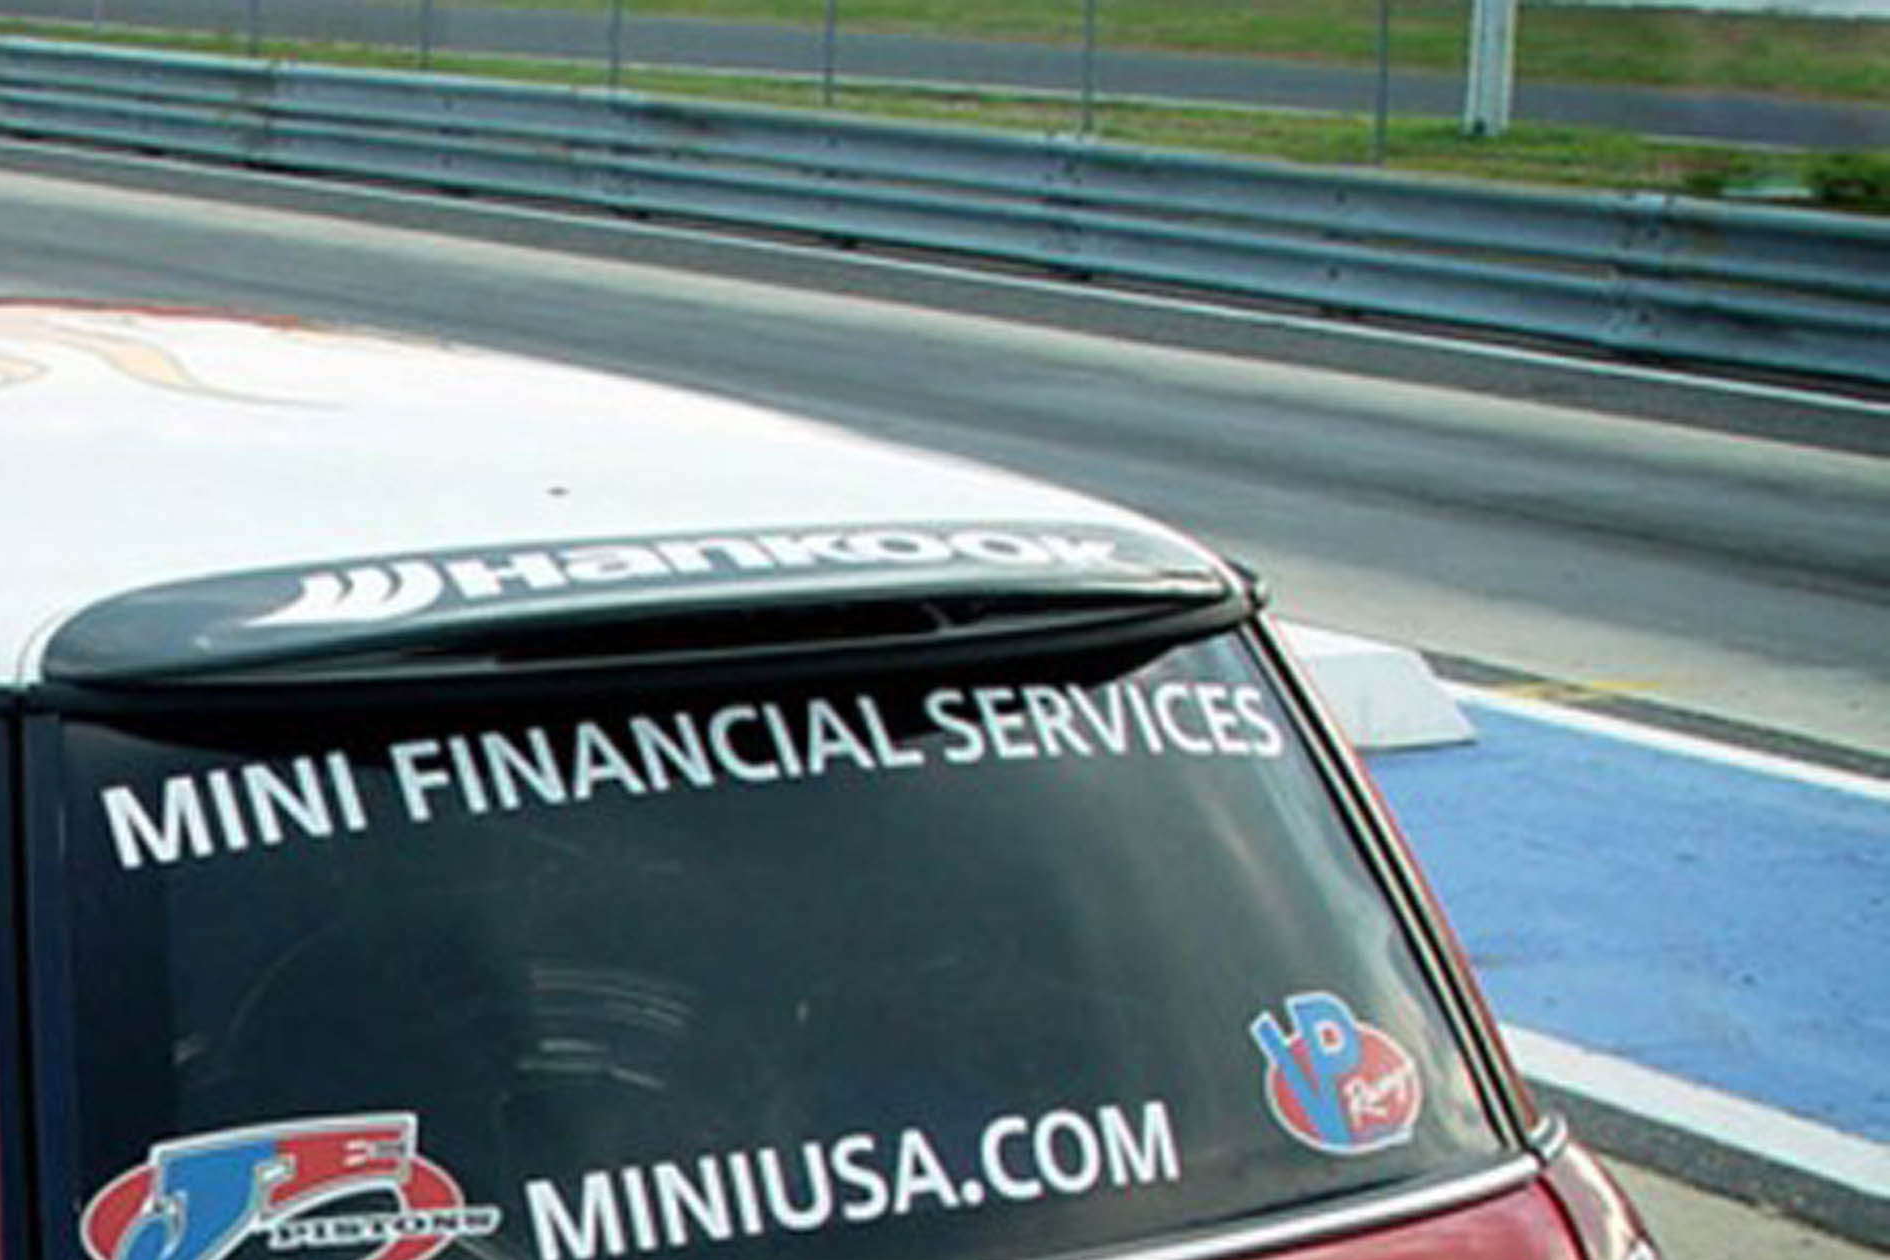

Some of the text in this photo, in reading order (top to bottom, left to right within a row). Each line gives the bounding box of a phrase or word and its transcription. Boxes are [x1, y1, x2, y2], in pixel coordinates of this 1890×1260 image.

[103, 680, 1284, 871] MINI FINANCIAL SERVICES
